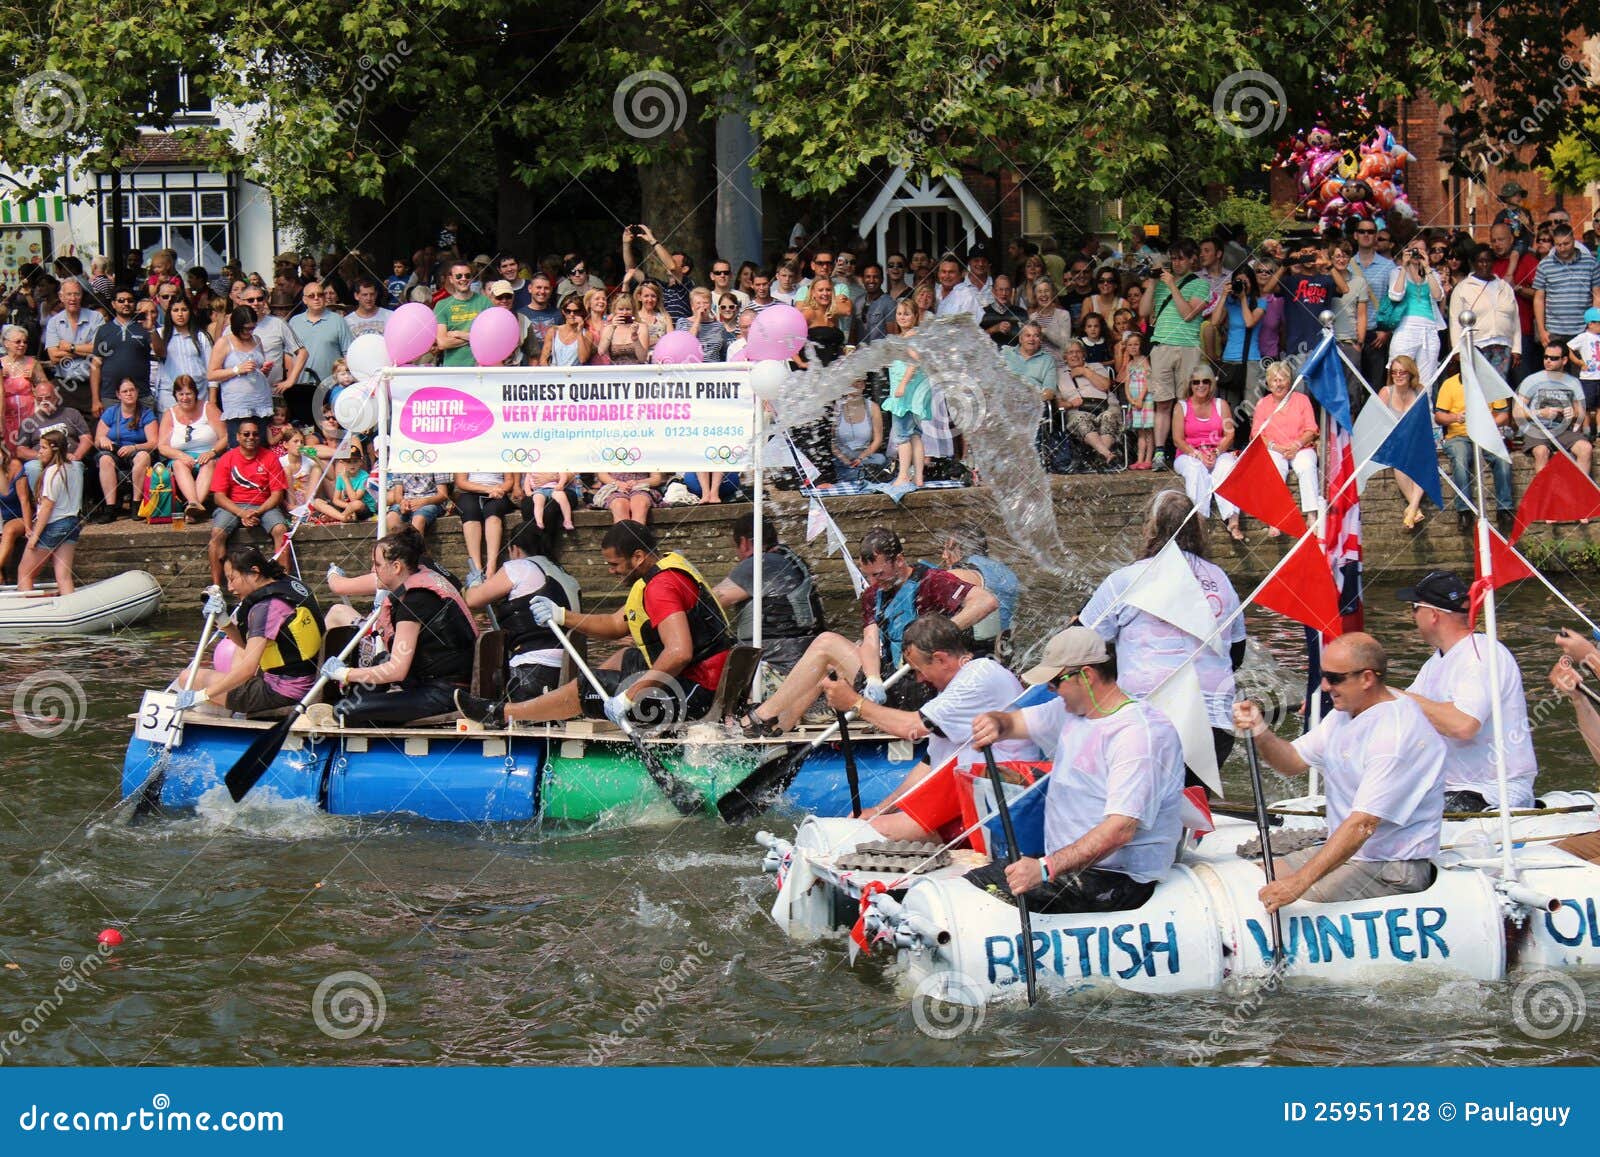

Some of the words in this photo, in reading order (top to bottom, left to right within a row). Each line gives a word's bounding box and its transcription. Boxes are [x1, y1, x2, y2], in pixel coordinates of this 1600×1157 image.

[502, 384, 565, 401] HIGHEST
[569, 383, 631, 402] QUALITY
[635, 382, 692, 400] DIGITAL
[696, 382, 741, 399] PRINT
[412, 400, 467, 416] DIGITAL
[502, 405, 539, 422] VERY
[543, 404, 634, 422] AFFORDABLE
[637, 403, 691, 420] PRICES
[412, 416, 454, 433] PRINT
[664, 427, 699, 437] 01234
[702, 426, 744, 437] 848436
[984, 922, 1180, 985] BRITISH
[1246, 906, 1450, 963] WINTER
